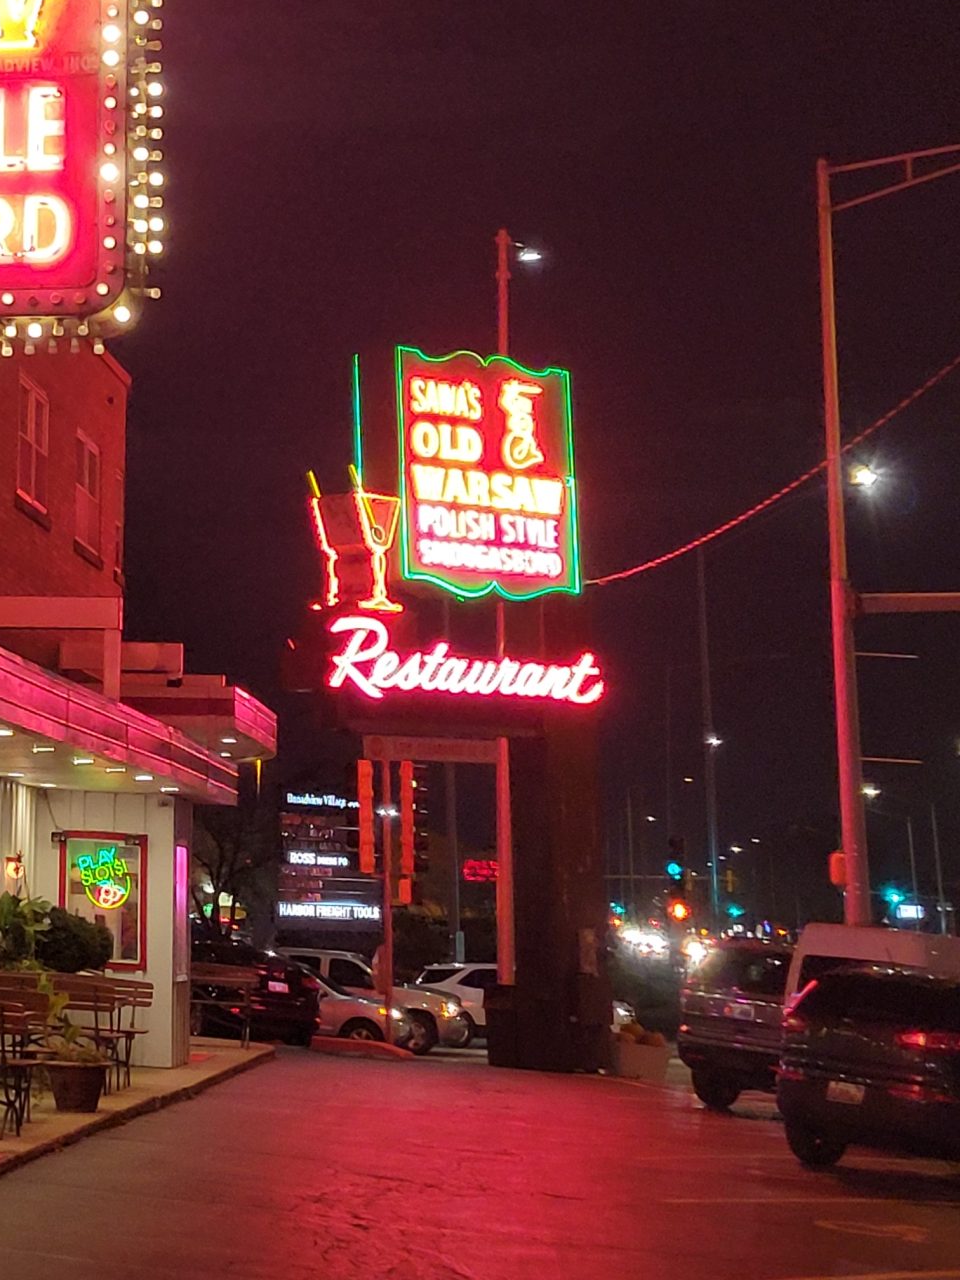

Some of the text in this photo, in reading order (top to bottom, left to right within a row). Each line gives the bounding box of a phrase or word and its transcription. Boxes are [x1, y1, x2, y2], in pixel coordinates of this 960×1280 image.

[409, 376, 483, 421] SAWA'S
[410, 422, 483, 463] OLD
[410, 464, 565, 516] WARSAW
[418, 504, 560, 549] POLISH STYLE
[329, 616, 605, 704] Restaurant
[78, 847, 116, 870] PLAY
[289, 852, 316, 865] ROSS
[316, 904, 353, 919] FREIGHT
[352, 906, 381, 919] TOOLS
